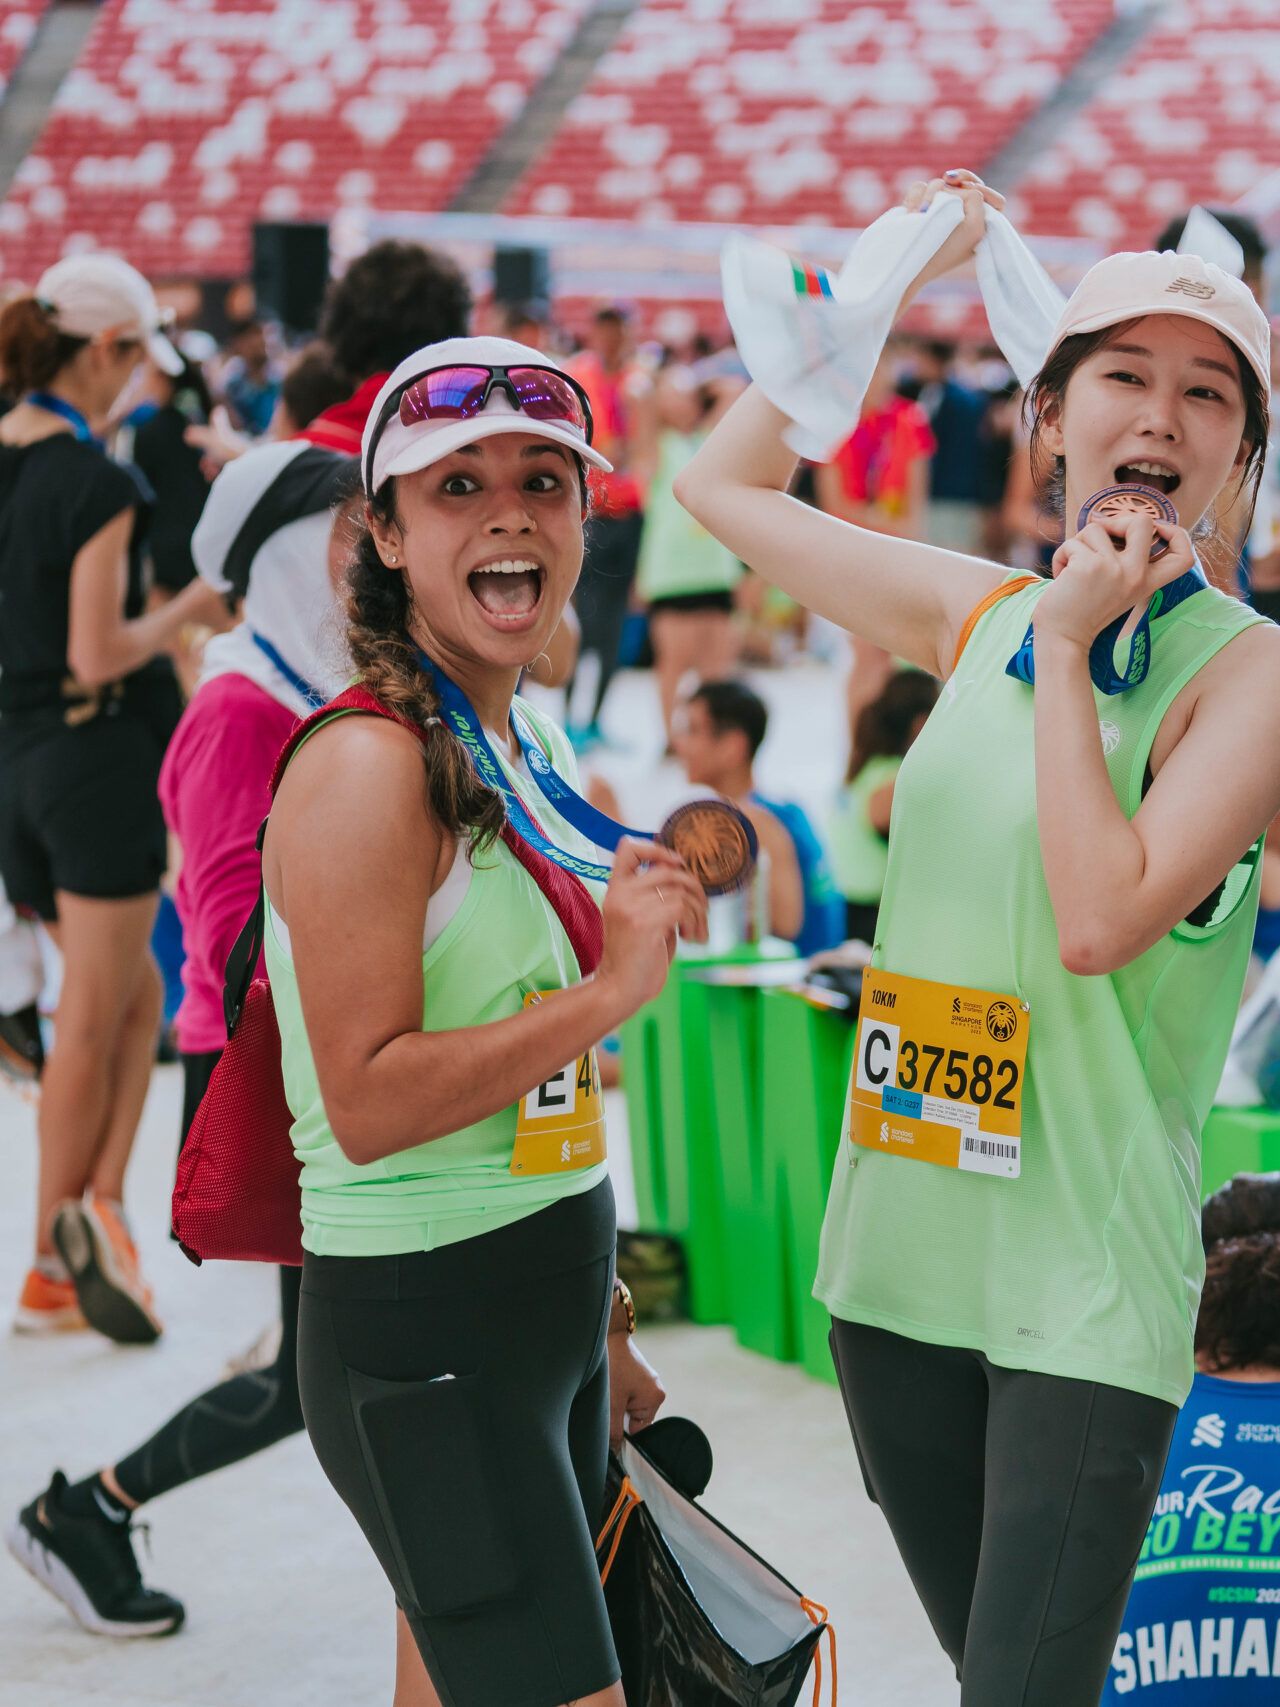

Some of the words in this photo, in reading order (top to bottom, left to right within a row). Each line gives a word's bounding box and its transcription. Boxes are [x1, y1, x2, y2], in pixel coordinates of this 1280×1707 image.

[872, 989, 897, 1009] 10KM
[951, 1015, 982, 1026] SINGAPORE
[864, 1028, 892, 1085] C
[898, 1040, 1019, 1110] 37582
[537, 1071, 567, 1108] E
[885, 1094, 897, 1104] SAT
[1017, 1327, 1046, 1340] DRYCELL
[1152, 1490, 1185, 1514] UR
[1180, 1557, 1244, 1570] CHARTERED
